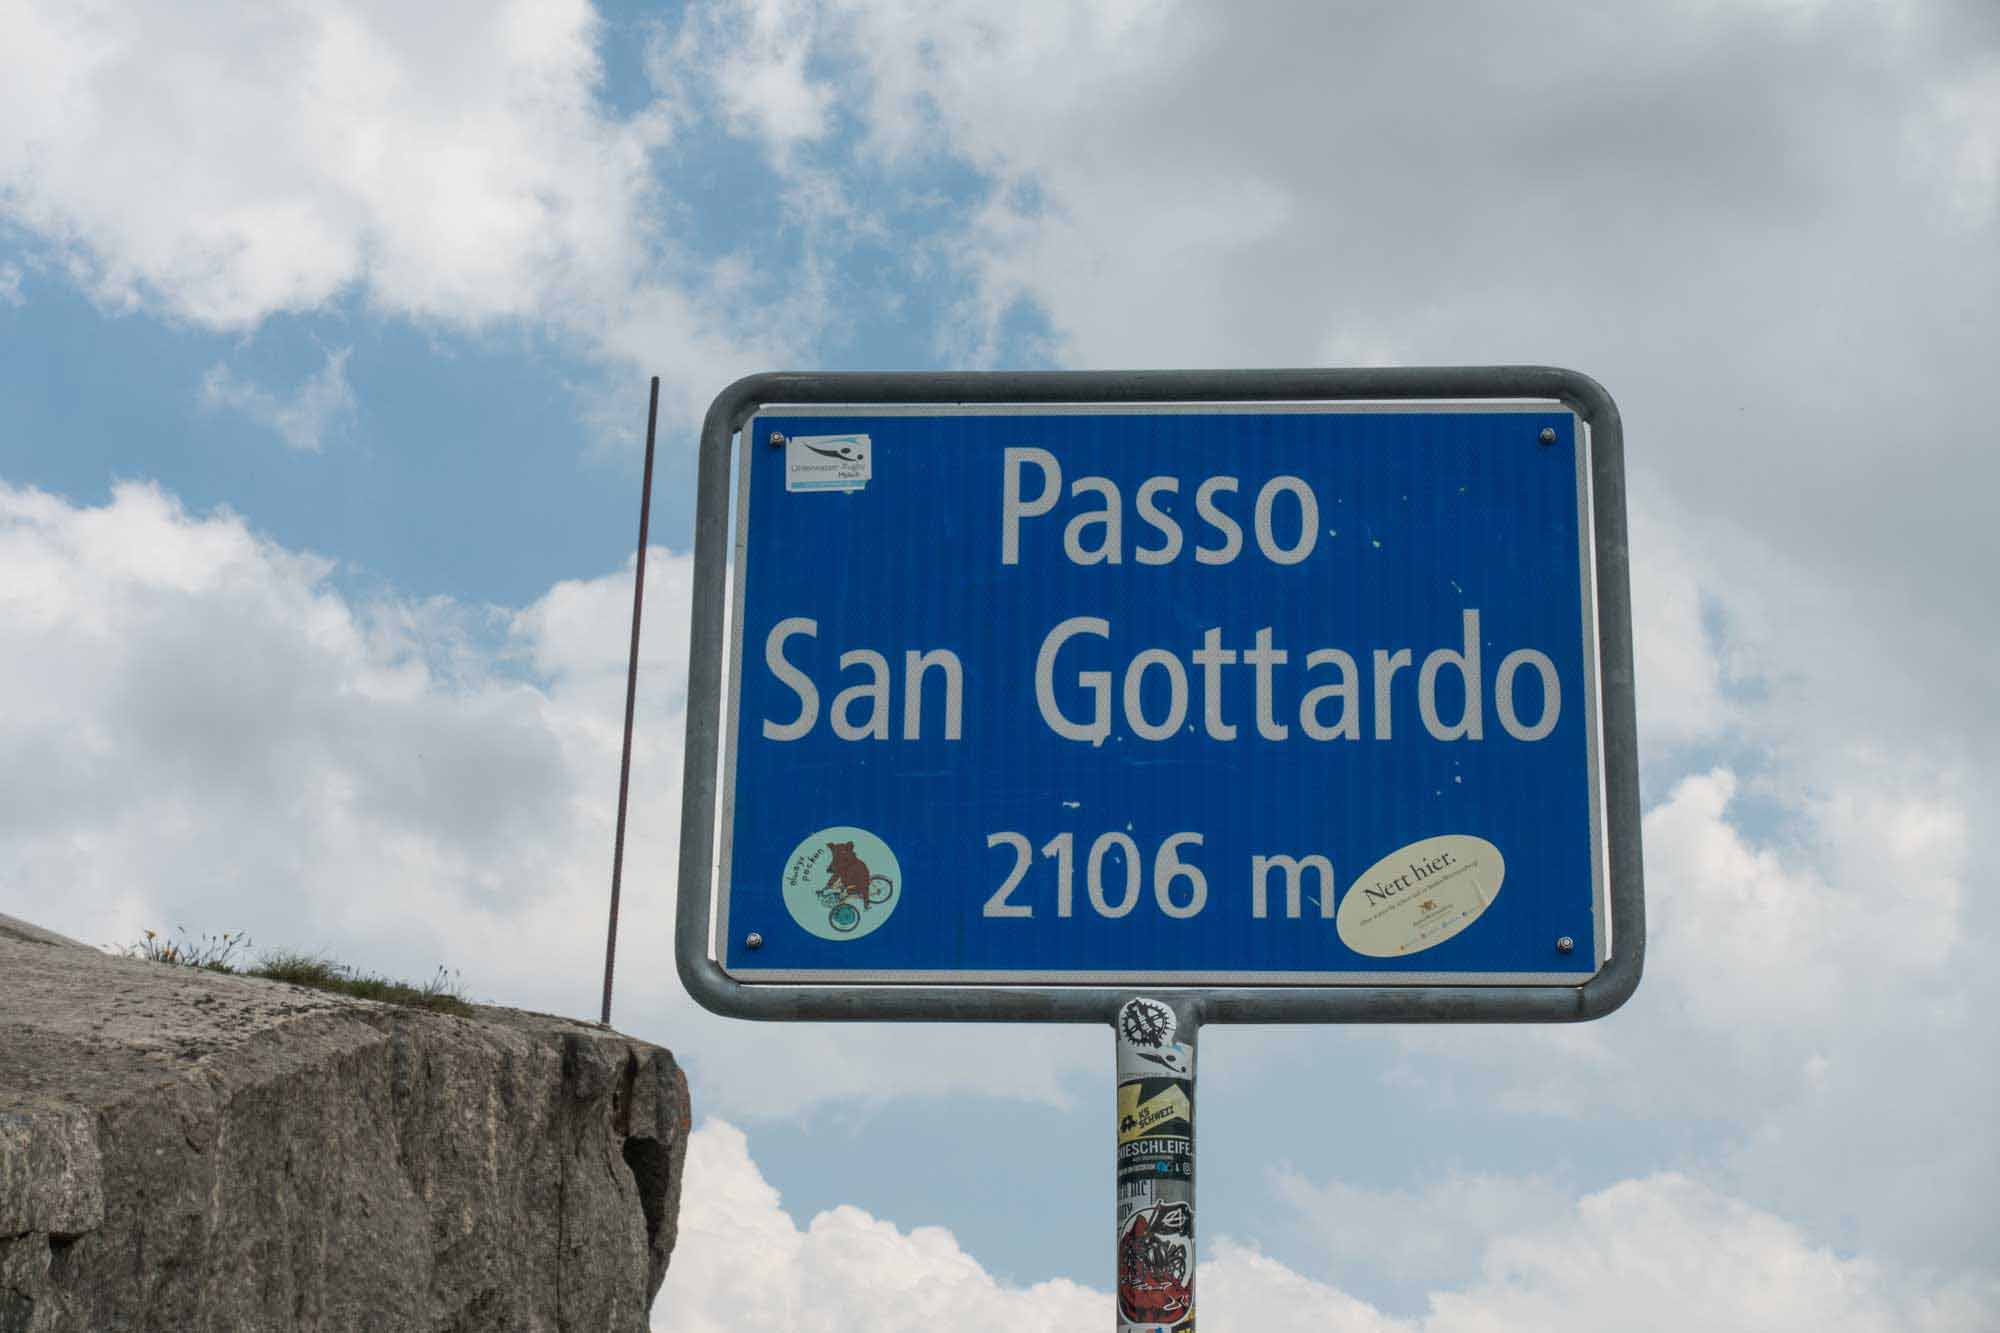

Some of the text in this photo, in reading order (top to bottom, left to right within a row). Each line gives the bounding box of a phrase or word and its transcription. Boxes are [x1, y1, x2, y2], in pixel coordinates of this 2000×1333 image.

[1002, 447, 1319, 566] Passo
[763, 608, 1562, 743] San Gottardo
[983, 831, 1208, 919] 2106
[1252, 854, 1337, 919] m
[1363, 874, 1412, 907] Nett
[1409, 852, 1457, 881] hier.
